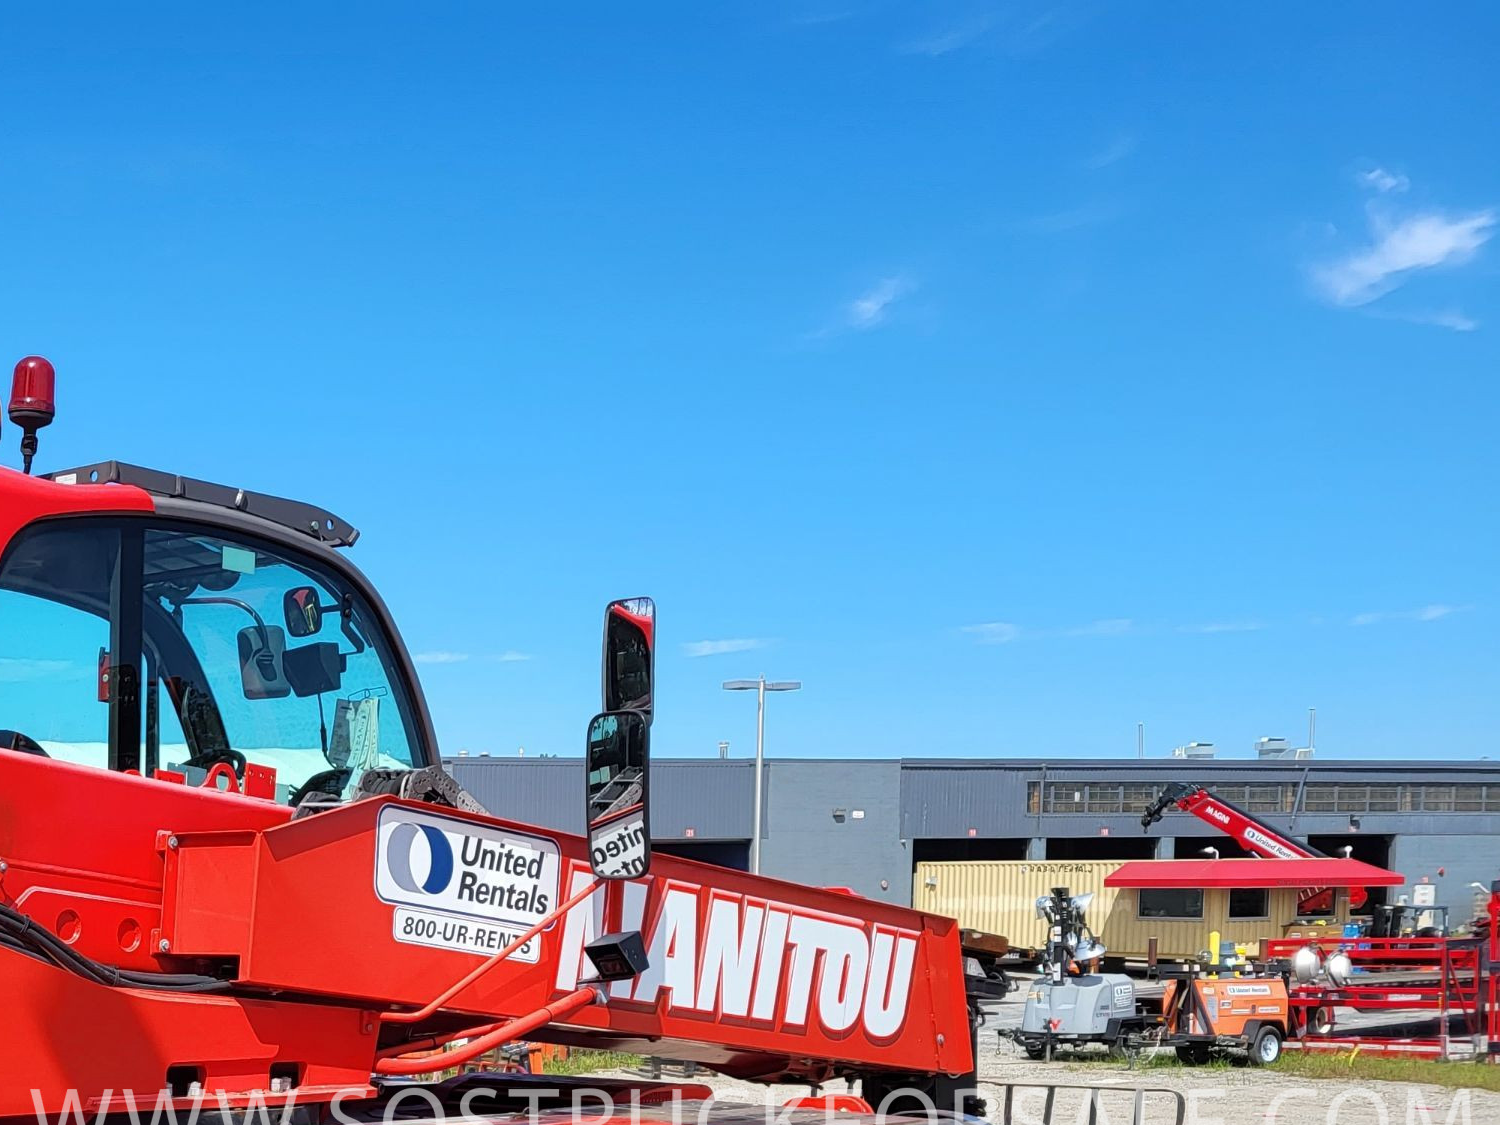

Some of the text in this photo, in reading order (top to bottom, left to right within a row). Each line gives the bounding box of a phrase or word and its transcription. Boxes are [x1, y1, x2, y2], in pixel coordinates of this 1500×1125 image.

[1205, 806, 1231, 825] MAGNI
[460, 835, 545, 880] United
[1255, 835, 1277, 851] United
[457, 870, 549, 915] Rentals
[553, 868, 919, 1039] MANITOU
